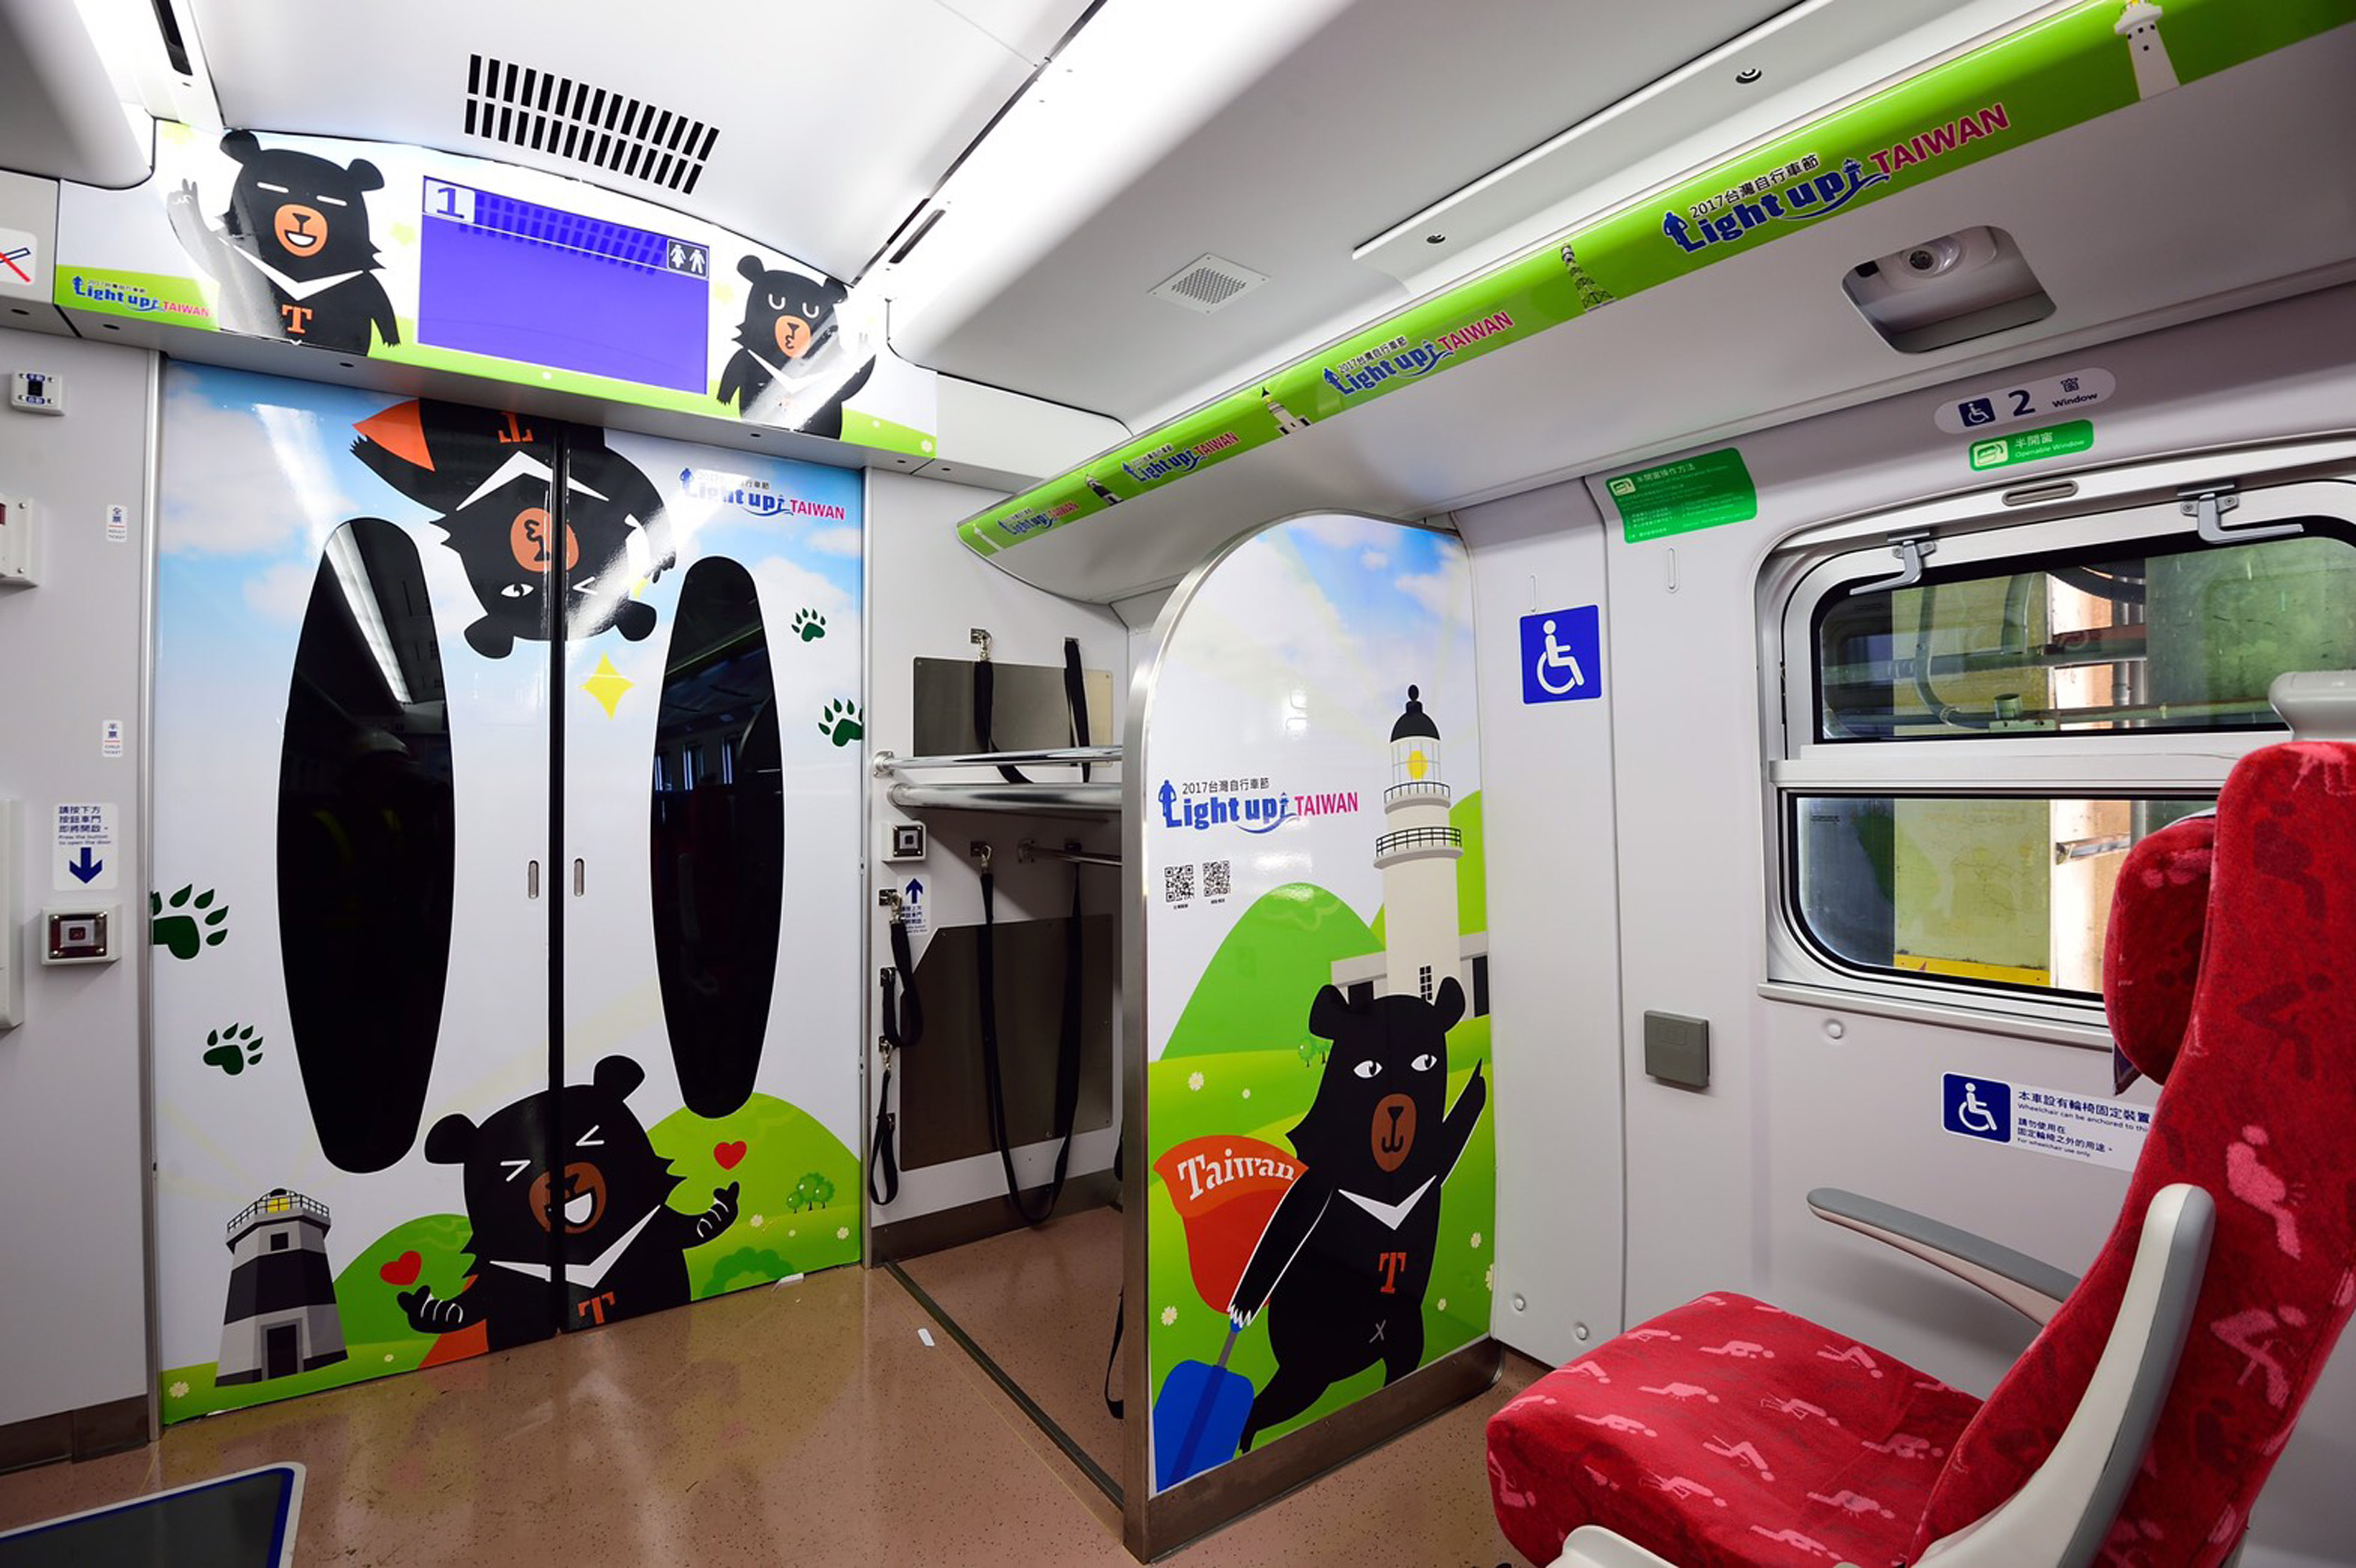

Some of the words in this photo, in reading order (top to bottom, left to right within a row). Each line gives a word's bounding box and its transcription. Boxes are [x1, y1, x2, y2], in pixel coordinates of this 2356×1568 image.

[1663, 192, 1785, 253] Light
[1870, 102, 2010, 175] TAIWAN
[1690, 153, 1820, 219] 2017台灣自行車節
[437, 188, 465, 219] 1
[72, 276, 124, 302] Light
[163, 301, 210, 317] TAIWAN
[282, 304, 313, 334] T
[1323, 359, 1396, 394] Light
[1437, 312, 1514, 351] TAIWAN
[2008, 389, 2036, 416] 2
[2052, 393, 2098, 408] Window
[1193, 431, 1240, 458] TAIWAN
[2052, 440, 2085, 451] Window
[790, 499, 846, 521] TAIWAN
[1182, 777, 1269, 795] 2017台灣自行車節
[1158, 780, 1239, 830] Light
[1294, 792, 1359, 817] TAIWAN
[2018, 1102, 2058, 1115] Wheelchair
[2087, 1117, 2124, 1128] anchored
[2029, 1140, 2063, 1151] wheelchair
[1177, 1148, 1295, 1201] Taiwan
[1378, 1252, 1407, 1293] T
